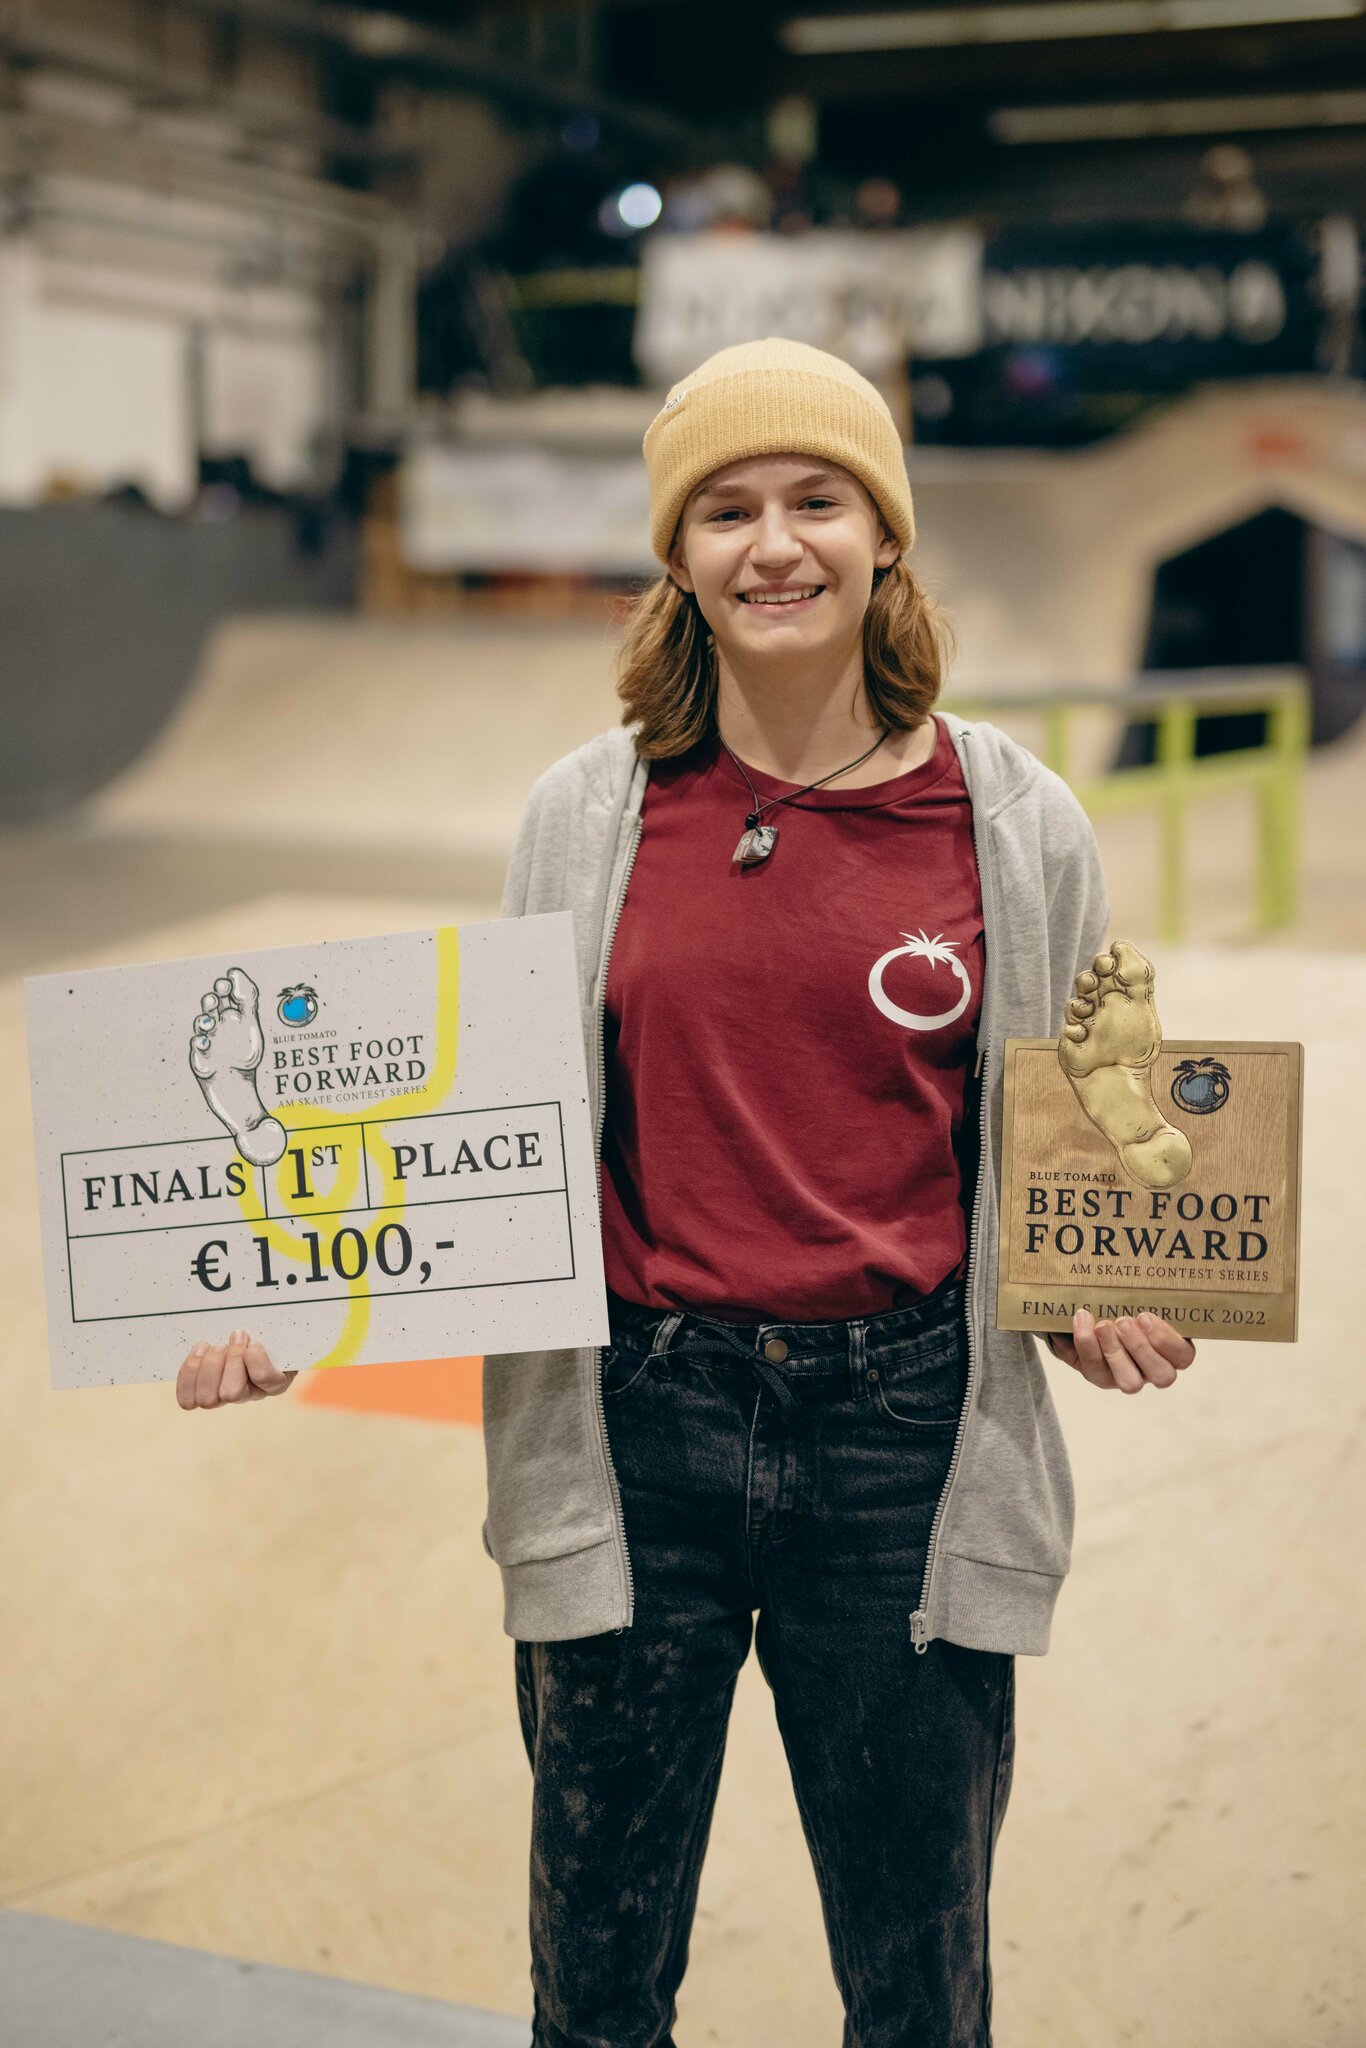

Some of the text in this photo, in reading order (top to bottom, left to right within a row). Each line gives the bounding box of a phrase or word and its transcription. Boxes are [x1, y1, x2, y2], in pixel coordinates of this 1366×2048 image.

[273, 1030, 337, 1044] BLUE TOMATO
[273, 1035, 424, 1069] BEST FOOT
[275, 1059, 426, 1095] FORWARD
[278, 1085, 428, 1108] AM SKATE CONTEST SERIES
[82, 1132, 543, 1211] FINALS 1ST PLACE
[1029, 1171, 1116, 1183] BLUE TOMATO
[1026, 1187, 1270, 1223] BEST FOOT
[190, 1223, 454, 1292] € 1.100,-
[1025, 1223, 1268, 1262] FORWARD
[1069, 1264, 1269, 1282] AM SKATE CONTEST SERIES
[1222, 1309, 1266, 1325] 2022
